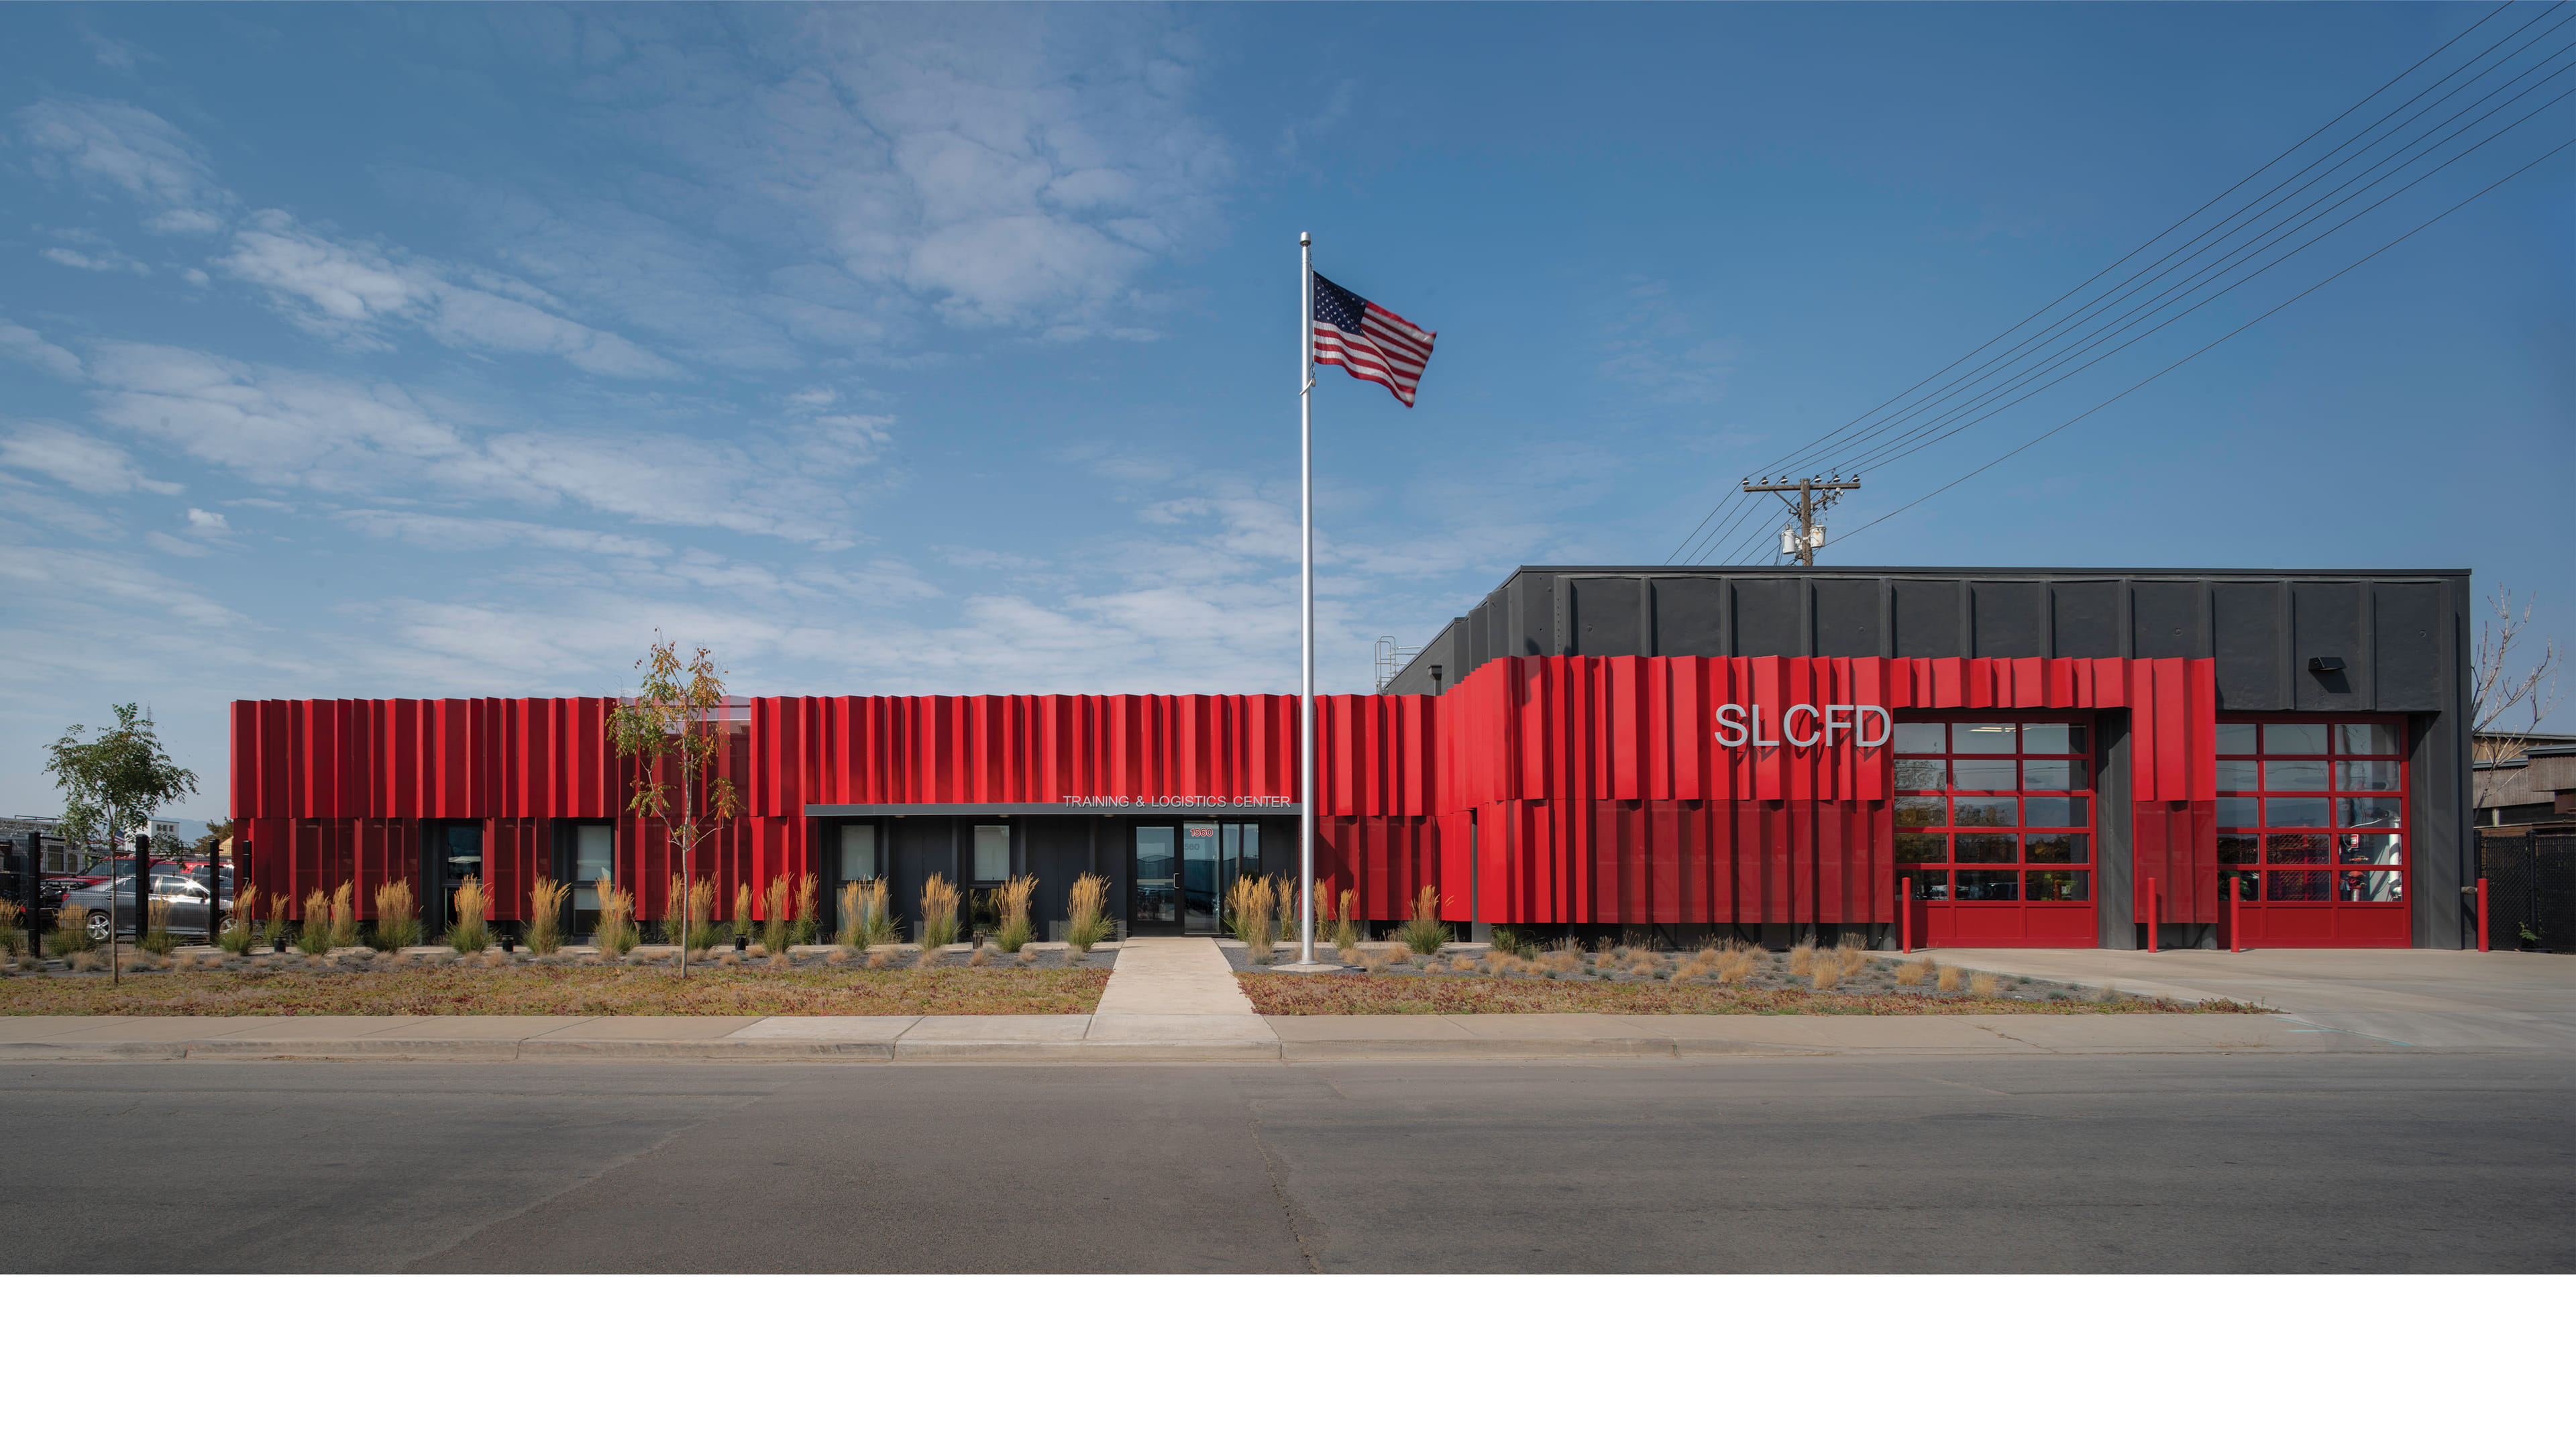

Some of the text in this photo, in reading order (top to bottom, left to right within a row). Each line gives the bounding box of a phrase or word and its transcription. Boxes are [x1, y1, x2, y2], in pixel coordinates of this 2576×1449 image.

[1715, 704, 1891, 747] SLCFD
[1063, 796, 1291, 808] TRAINING & LOGISTICS CENTER
[1190, 828, 1214, 837] 1560
